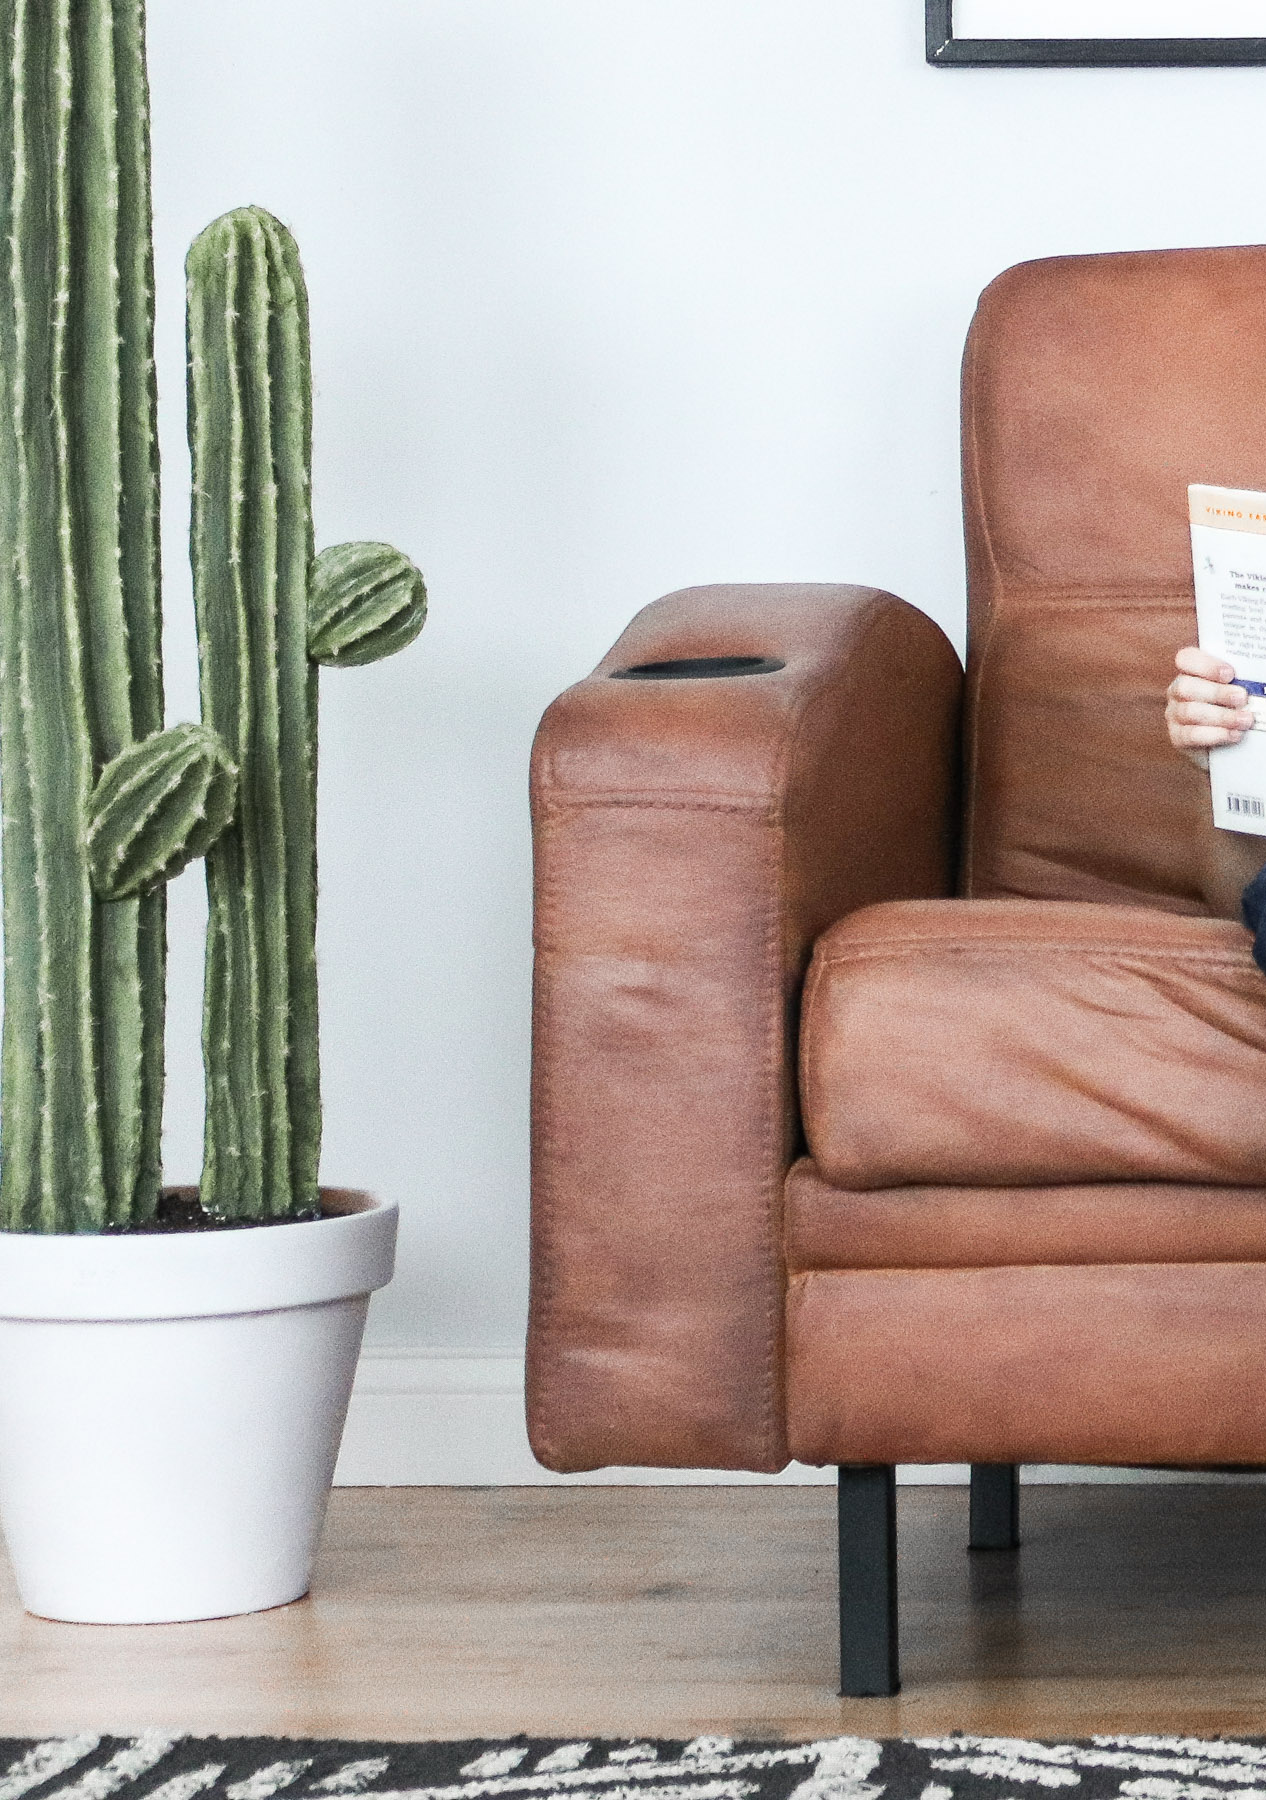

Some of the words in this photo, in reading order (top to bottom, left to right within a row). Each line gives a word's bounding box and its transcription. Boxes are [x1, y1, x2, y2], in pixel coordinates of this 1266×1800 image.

[1205, 506, 1243, 519] VIKING
[1229, 570, 1245, 579] The
[1234, 582, 1260, 592] makes
